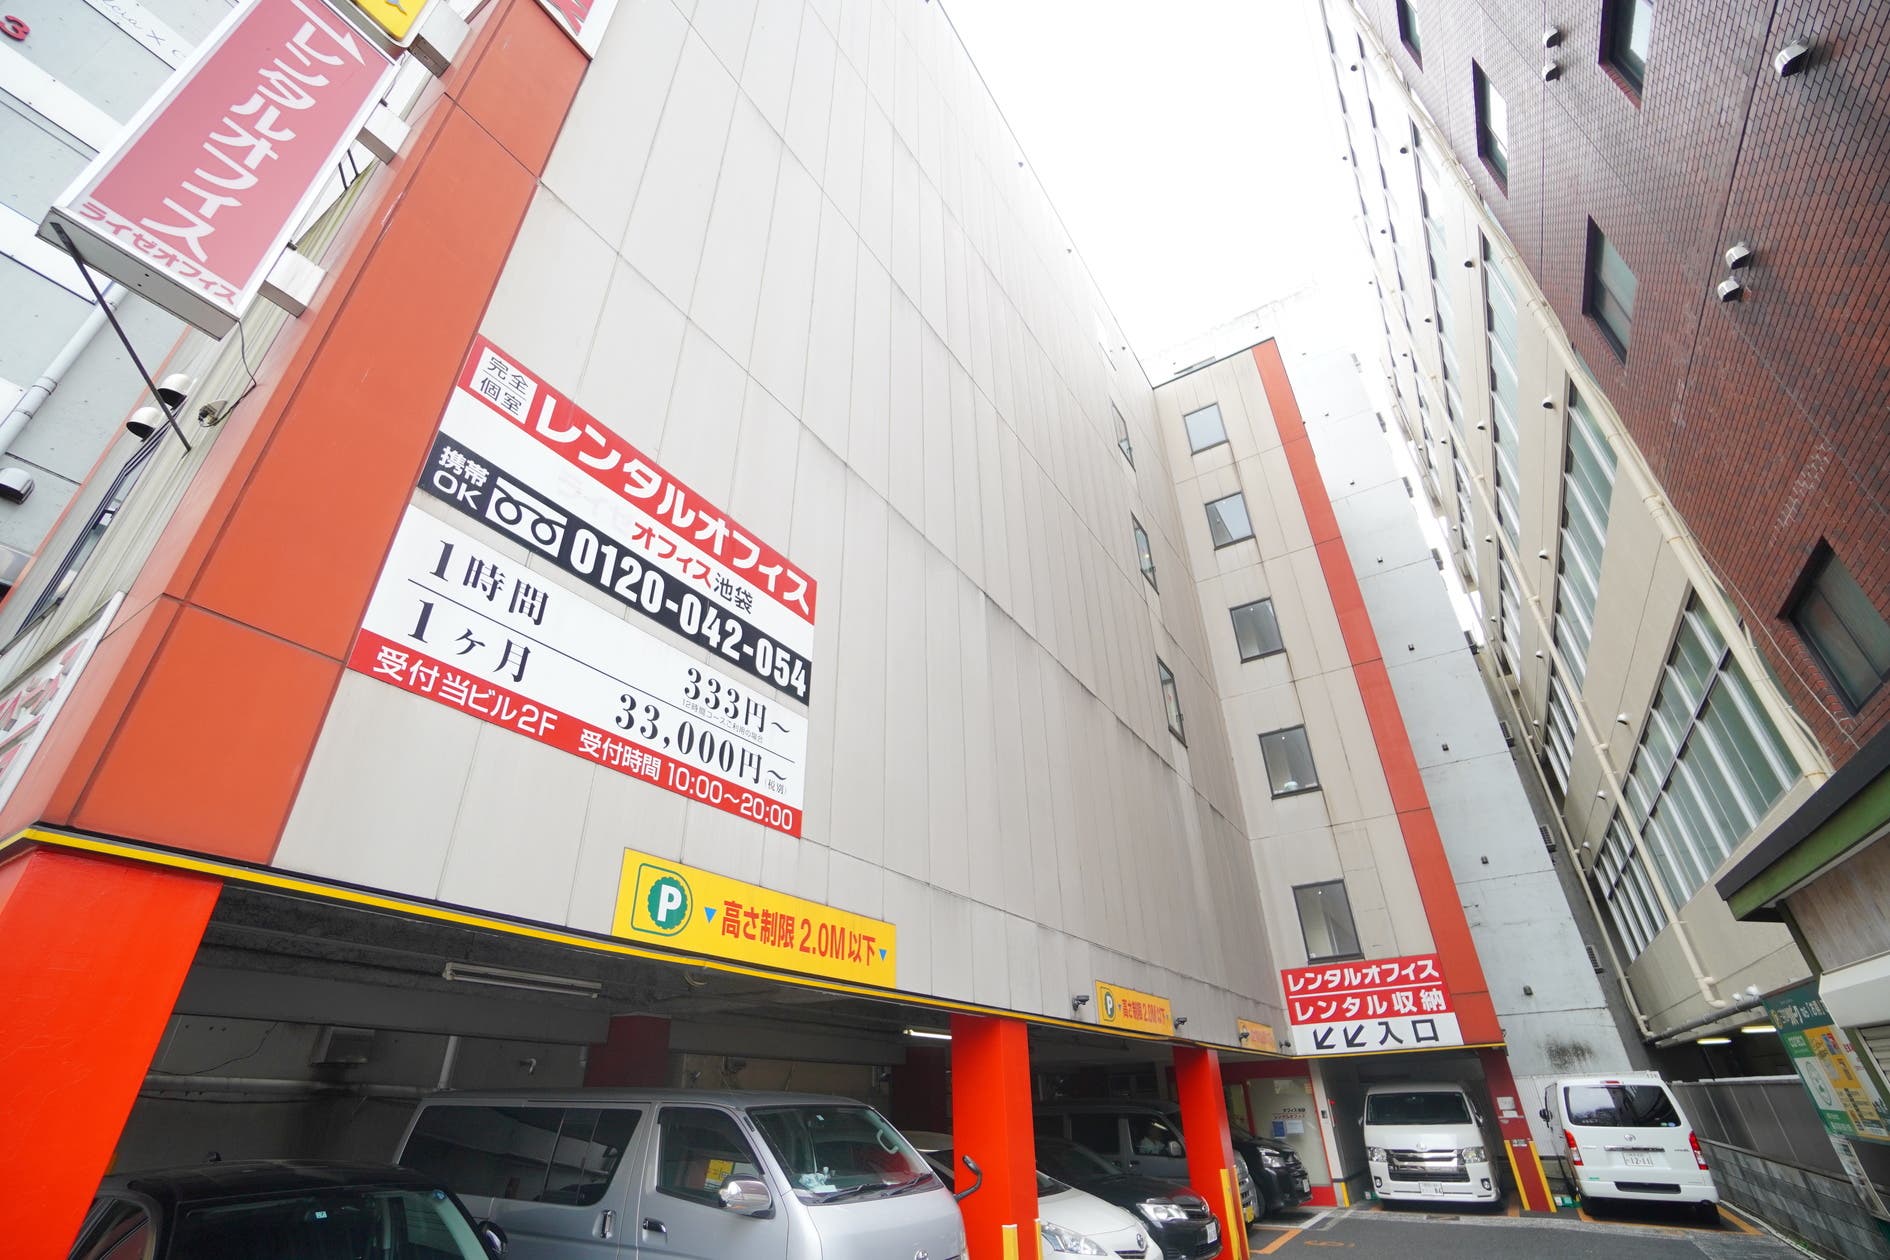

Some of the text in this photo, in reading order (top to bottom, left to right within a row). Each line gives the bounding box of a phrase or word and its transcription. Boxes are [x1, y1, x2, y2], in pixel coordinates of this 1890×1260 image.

[141, 21, 345, 262] レンタルオフィス
[78, 201, 236, 306] ライゼオフィス
[480, 377, 522, 416] 個室
[487, 357, 529, 395] 完全
[438, 445, 490, 488] 携帯
[432, 469, 482, 512] OK
[535, 393, 810, 616] レンタルオフィス
[569, 527, 808, 698] 0120-042-054
[373, 646, 558, 736] 受付当ビル2F
[578, 729, 662, 782] 受付時間
[657, 884, 682, 922] P
[1288, 959, 1440, 992] レンタルオフィス
[1295, 988, 1447, 1022] レンタル収納
[1378, 1018, 1439, 1046] 入口
